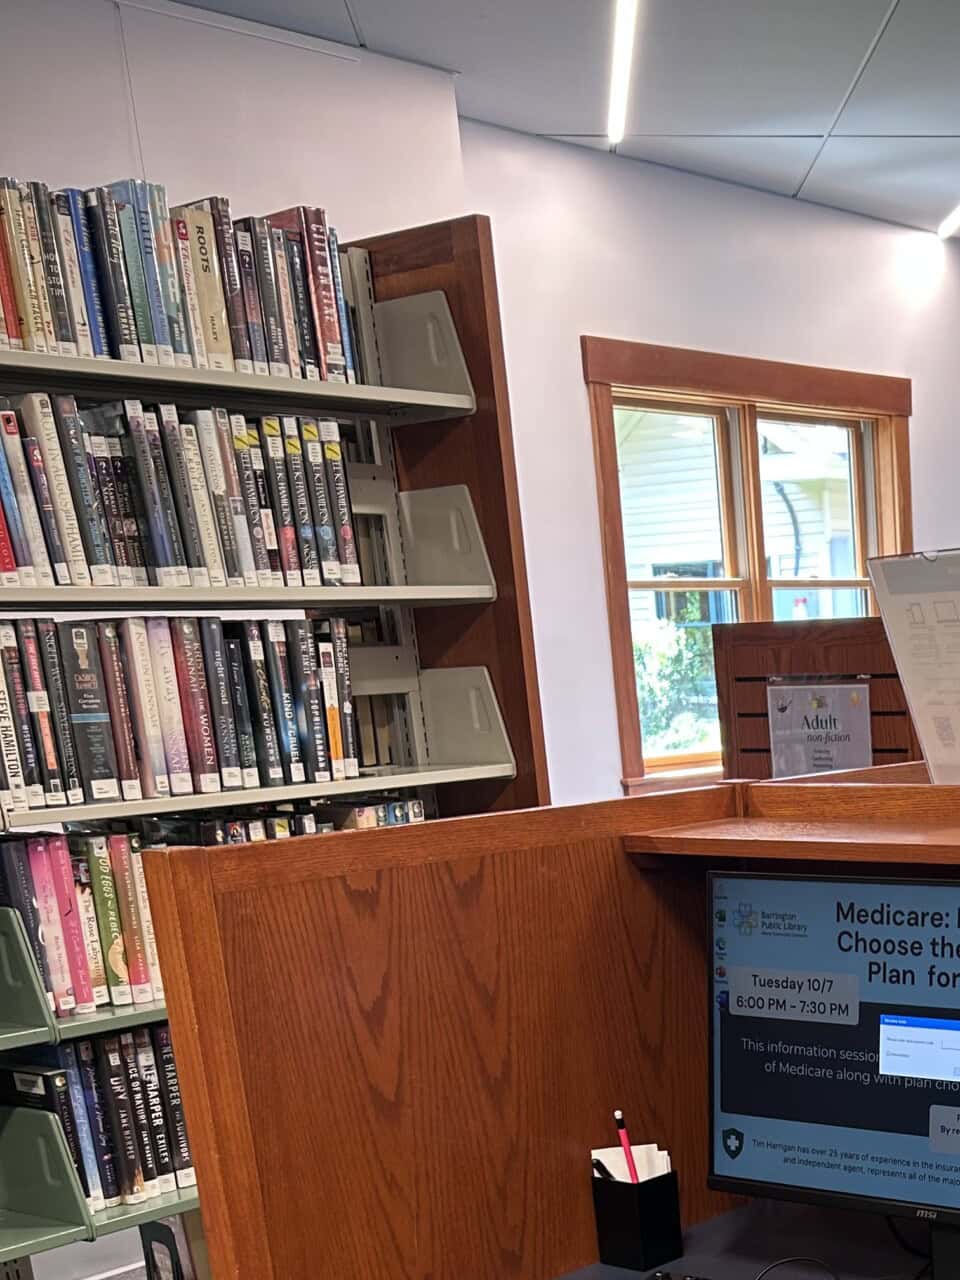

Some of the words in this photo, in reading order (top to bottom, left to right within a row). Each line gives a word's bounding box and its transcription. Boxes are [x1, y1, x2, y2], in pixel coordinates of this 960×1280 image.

[195, 225, 210, 272] ROOTS
[118, 303, 129, 340] LIBRARY
[209, 316, 218, 342] HALEY
[246, 480, 260, 525] HAMILTON
[278, 483, 291, 525] HAMILTON
[295, 481, 309, 524] HAMILTON
[316, 483, 329, 526] HAMILTON
[336, 486, 348, 524] HAMILTON
[44, 630, 58, 663] NIGHT
[136, 632, 150, 677] KRISTIN
[144, 680, 158, 728] HANNAH
[183, 640, 198, 692] HANNAH
[192, 642, 206, 690] KRISTIN
[214, 650, 224, 679] night
[219, 682, 228, 705] road
[161, 666, 176, 705] away
[57, 702, 68, 728] STEVE
[283, 692, 292, 719] KIND
[288, 730, 298, 762] CRUEL
[310, 699, 321, 730] SOPHIE
[802, 714, 838, 730] Adult
[1, 723, 20, 778] HAMILTON
[199, 715, 214, 765] WOMEN
[219, 716, 230, 757] HANNAH
[262, 713, 274, 762] MURDERS
[315, 734, 326, 768] HANNAH
[807, 732, 850, 744] non-fiction
[62, 731, 76, 777] HAMILTON
[101, 874, 113, 898] EGGS
[83, 899, 92, 913] The
[761, 911, 797, 920] Barrington
[836, 902, 950, 928] Medicare:
[85, 915, 97, 937] Rose
[761, 922, 782, 930] Public
[783, 923, 808, 932] Library
[837, 931, 923, 956] Choose
[752, 974, 804, 992] Tuesday
[808, 978, 833, 992] 10/7
[868, 962, 915, 985] Plan
[928, 965, 960, 988] for
[737, 996, 764, 1009] 6:00
[768, 999, 786, 1011] PM
[800, 1001, 826, 1014] 7:30
[830, 1003, 849, 1016] PM
[162, 1046, 172, 1060] NE
[741, 1038, 764, 1052] This
[768, 1040, 836, 1059] information
[131, 1081, 139, 1093] OF
[143, 1065, 154, 1081] NE
[164, 1064, 180, 1106] HARPER
[764, 1061, 776, 1072] of
[779, 1062, 833, 1078] Medicare
[837, 1068, 870, 1085] along
[110, 1075, 126, 1102] DRY
[119, 1110, 128, 1128] JANE
[134, 1094, 146, 1124] NATURE
[147, 1083, 162, 1126] HARPER
[940, 1125, 950, 1135] By
[156, 1134, 168, 1163] EXILES
[797, 1145, 810, 1154] has
[840, 1151, 860, 1160] years
[870, 1155, 910, 1168] experience
[921, 1161, 934, 1169] the
[798, 1157, 841, 1170] independent
[844, 1165, 865, 1174] agent,
[868, 1167, 906, 1178] represents
[909, 1171, 917, 1179] all
[928, 1174, 941, 1183] the
[916, 1209, 937, 1218] msi
